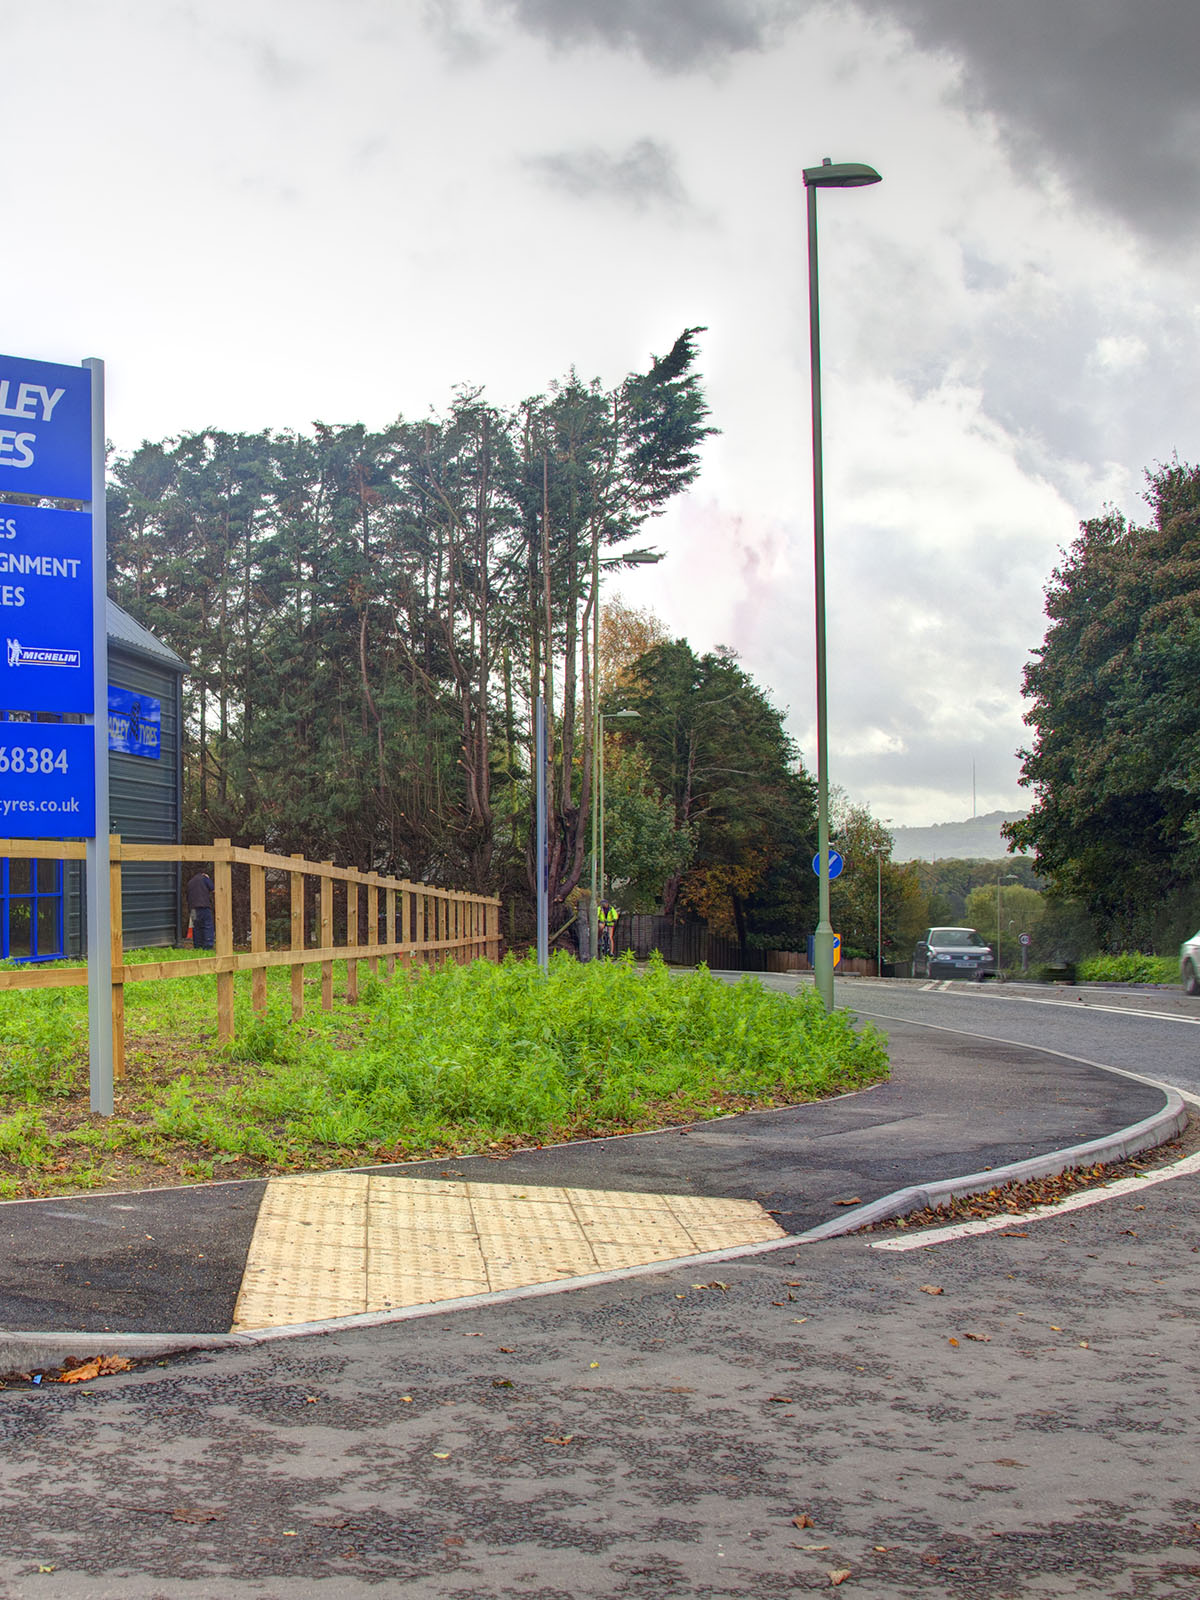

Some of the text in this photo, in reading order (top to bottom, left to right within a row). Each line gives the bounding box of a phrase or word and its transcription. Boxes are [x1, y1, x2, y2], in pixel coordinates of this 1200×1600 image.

[22, 651, 77, 662] MICHELIN
[108, 716, 158, 747] ADLEY TYRES
